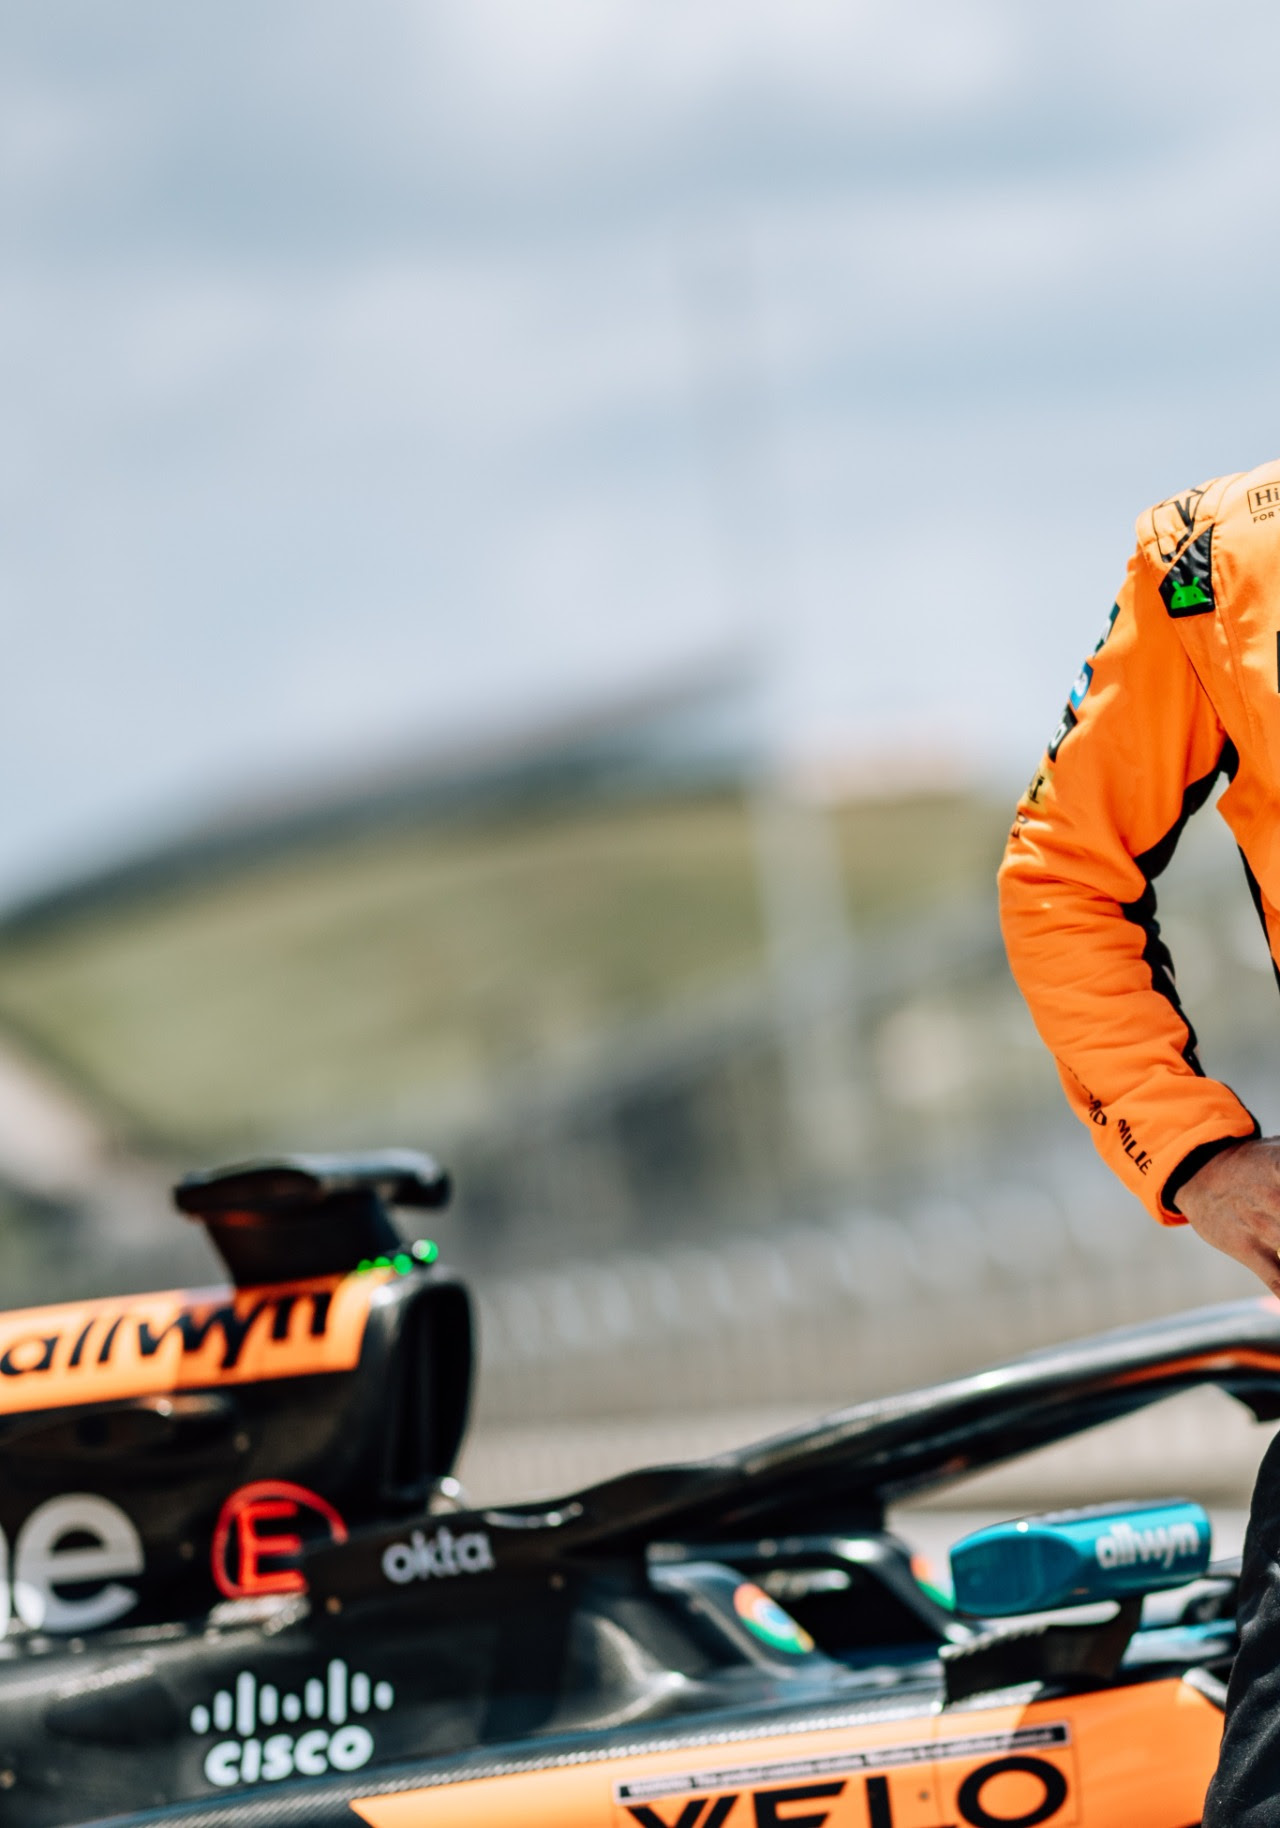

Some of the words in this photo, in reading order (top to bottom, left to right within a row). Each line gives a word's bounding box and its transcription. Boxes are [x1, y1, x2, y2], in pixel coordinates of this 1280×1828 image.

[1252, 511, 1275, 524] FOR
[1117, 1118, 1153, 1177] MILLE
[0, 1290, 337, 1377] allwyn
[381, 1526, 496, 1586] okta
[1095, 1520, 1200, 1571] allwyn
